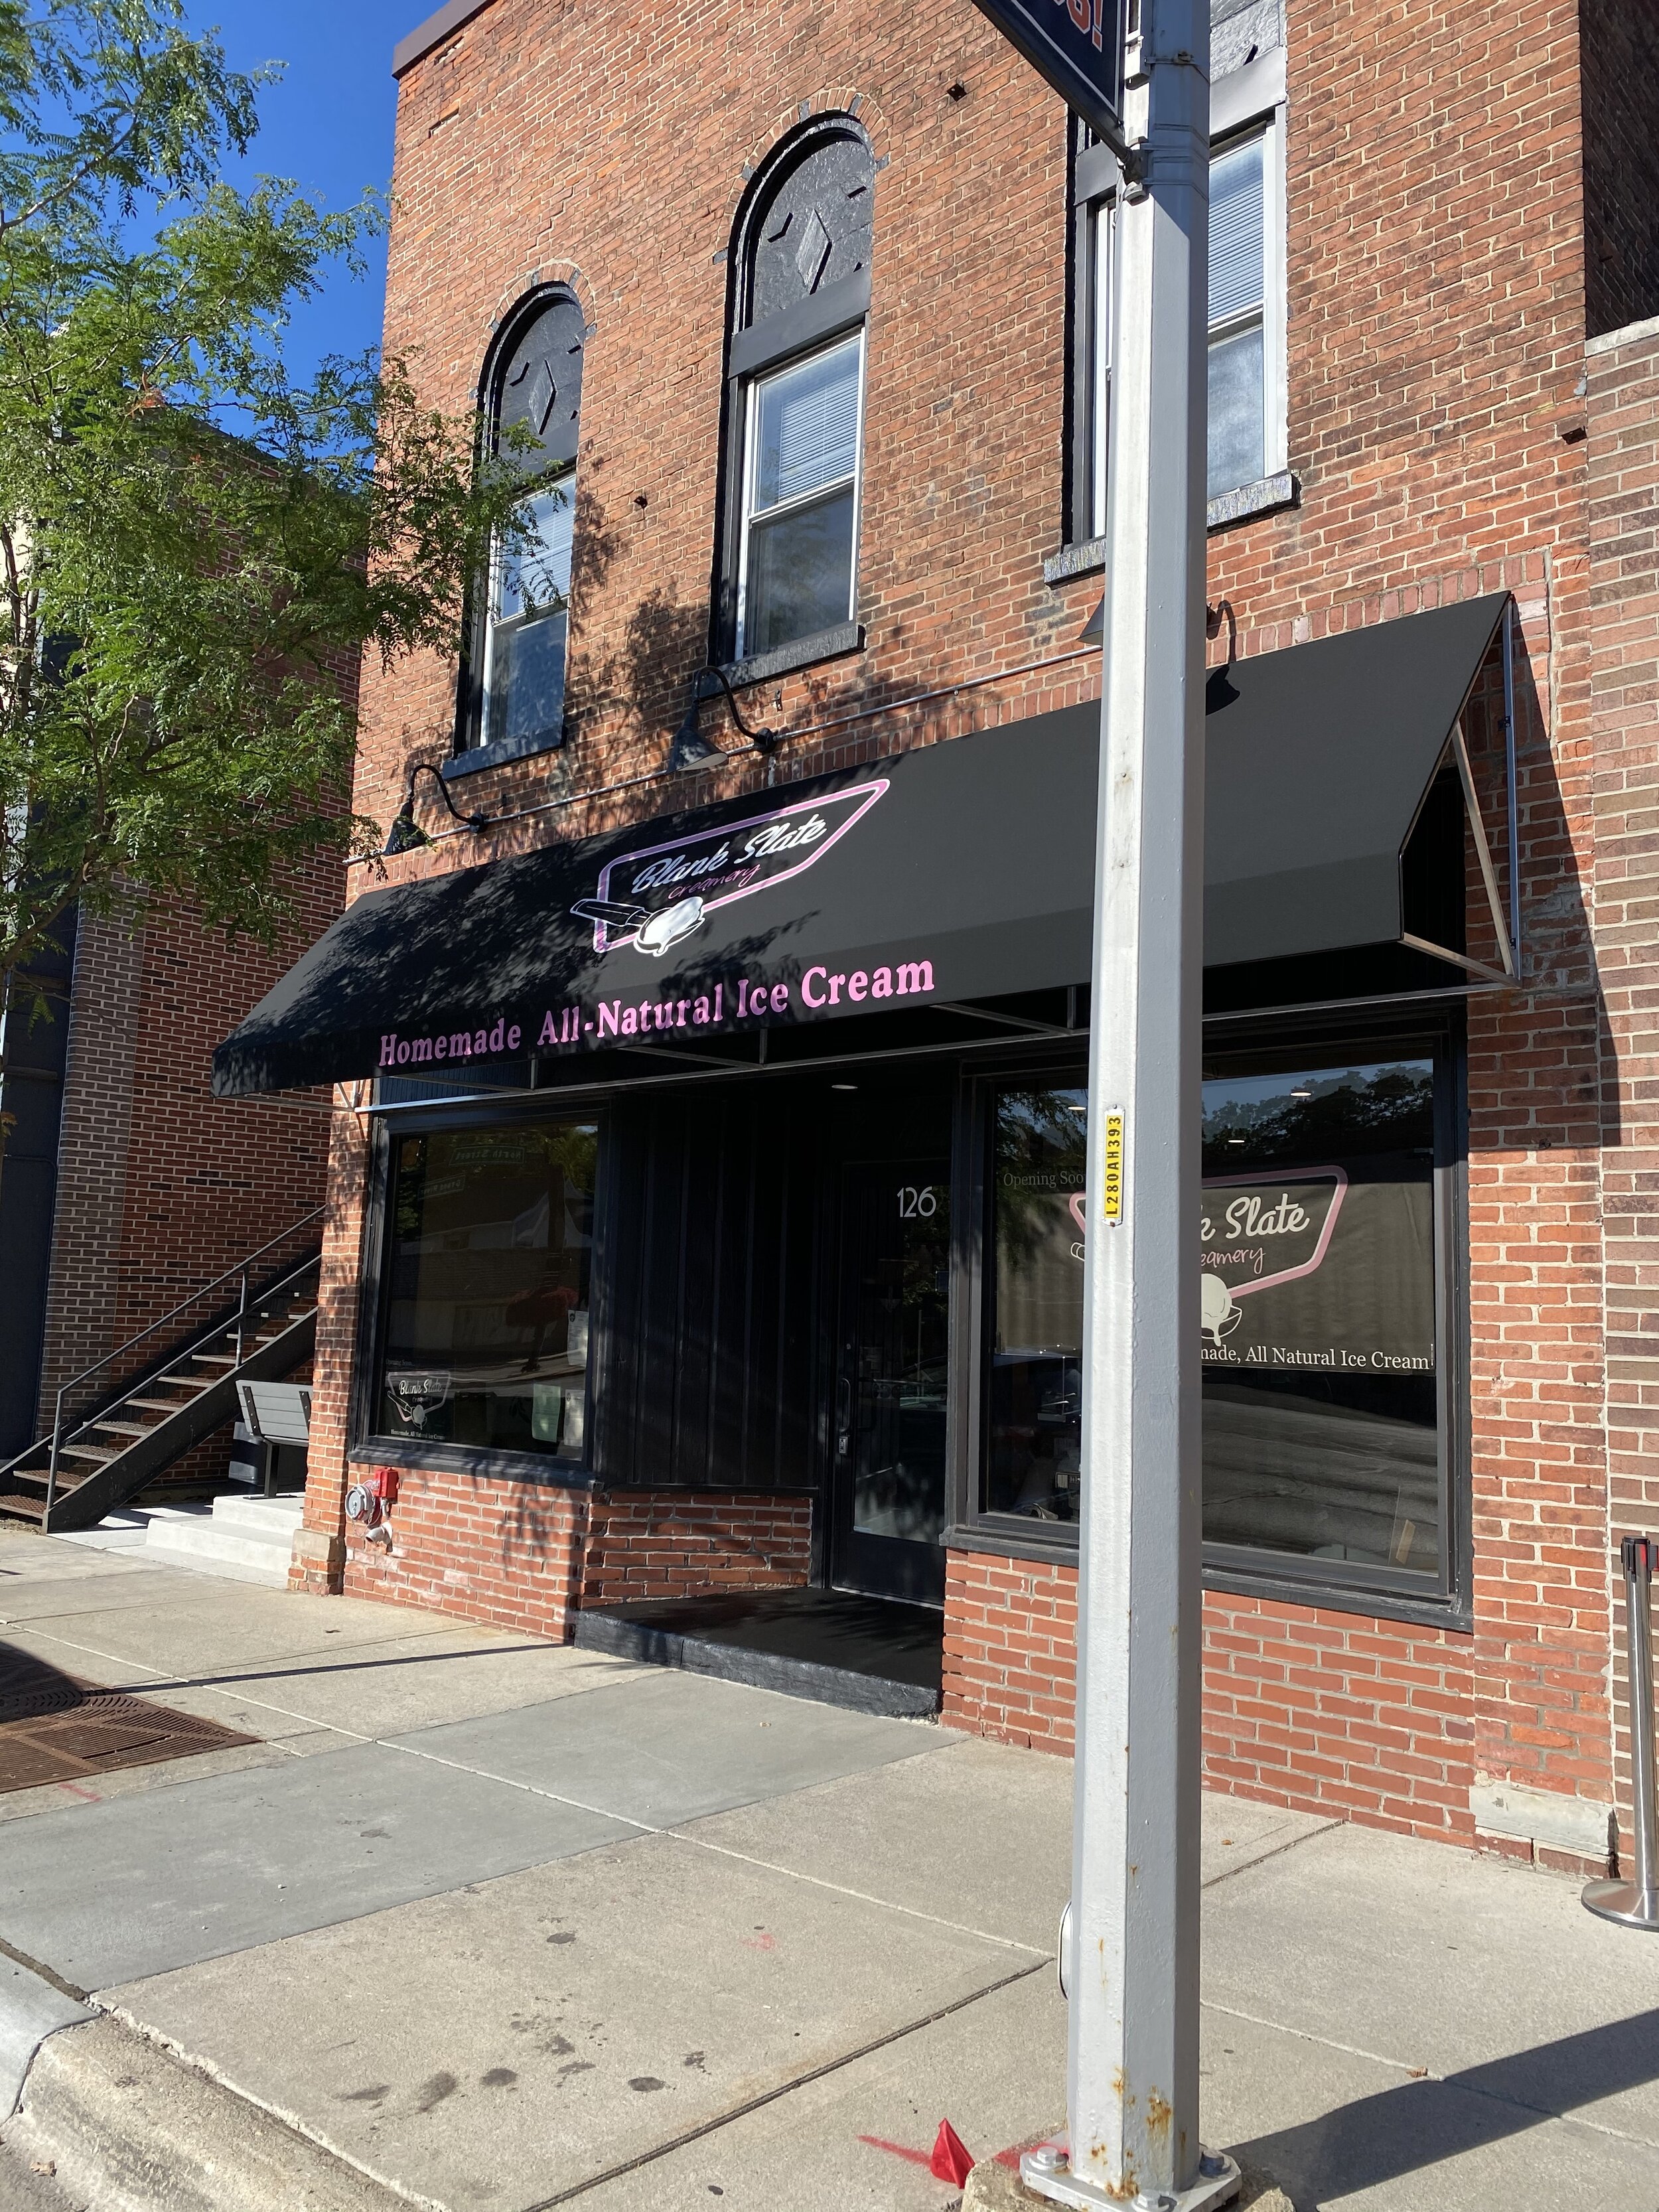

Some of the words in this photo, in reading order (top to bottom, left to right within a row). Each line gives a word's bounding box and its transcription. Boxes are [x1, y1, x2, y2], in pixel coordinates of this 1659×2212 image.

[631, 841, 729, 894] Blank
[734, 813, 828, 864] Slate
[667, 863, 762, 899] creamery
[378, 1017, 522, 1067] Homemade
[536, 982, 723, 1046] All-Natural
[736, 979, 789, 1018] Ice
[801, 960, 935, 1008] Cream
[1003, 1171, 1056, 1189] Opening
[1060, 1170, 1084, 1185] Soo
[1105, 1116, 1121, 1215] L280AH393
[897, 1186, 937, 1218] 126
[1225, 1193, 1310, 1239] Slate
[1201, 1247, 1266, 1275] eamery
[1245, 1345, 1268, 1363] All
[1271, 1347, 1336, 1366] Natural
[1340, 1349, 1366, 1368] Ice
[1371, 1351, 1430, 1370] Cream
[399, 1380, 422, 1396] Blank
[423, 1378, 443, 1394] Slate
